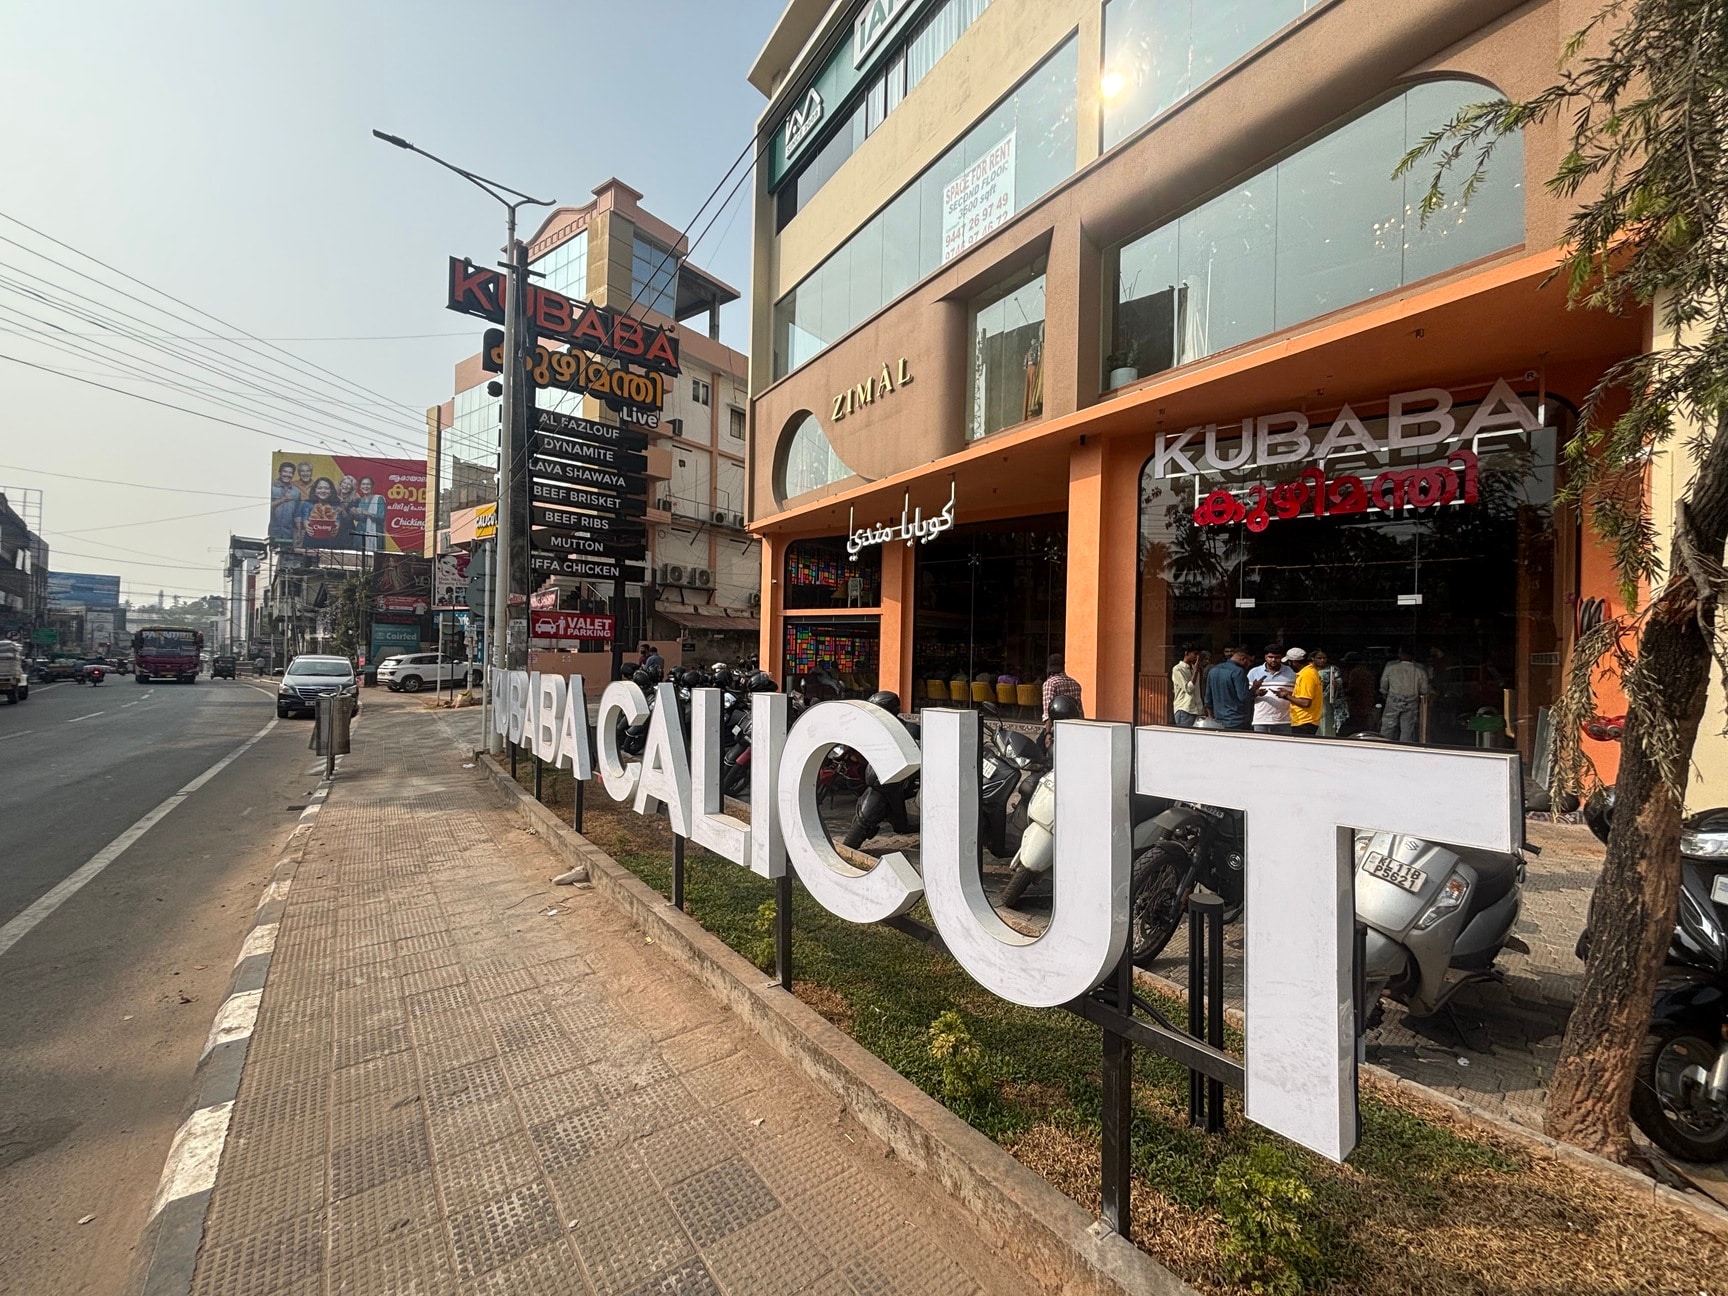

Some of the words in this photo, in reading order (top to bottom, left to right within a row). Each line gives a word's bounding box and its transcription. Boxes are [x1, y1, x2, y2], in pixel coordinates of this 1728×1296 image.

[945, 173, 970, 205] SPACE
[971, 158, 987, 187] FOR
[988, 138, 1012, 172] RENT
[948, 184, 979, 214] SECOND
[980, 183, 997, 205] sqft
[945, 223, 966, 247] 9447
[968, 213, 980, 232] 26
[982, 202, 994, 221] 97
[996, 191, 1009, 210] 49
[831, 356, 914, 422] ZIMÀL
[540, 412, 558, 426] AL
[561, 416, 620, 440] FAZLOUF
[622, 405, 658, 428] Live
[1154, 376, 1544, 480] KUBABA
[544, 438, 615, 462] DYNAMITE
[528, 459, 562, 475] LAVA
[565, 466, 626, 488] SHAWAYA
[533, 485, 567, 500] BEEF
[570, 491, 621, 509] BRISKET
[545, 511, 578, 525] BEEF
[581, 516, 609, 530] RIBS
[550, 536, 604, 552] MUTTON
[563, 561, 619, 577] CHICKEN
[567, 616, 612, 630] VALET
[567, 628, 611, 638] PARKING
[1373, 864, 1416, 889] P5621
[597, 680, 1524, 1165] CALICUT
